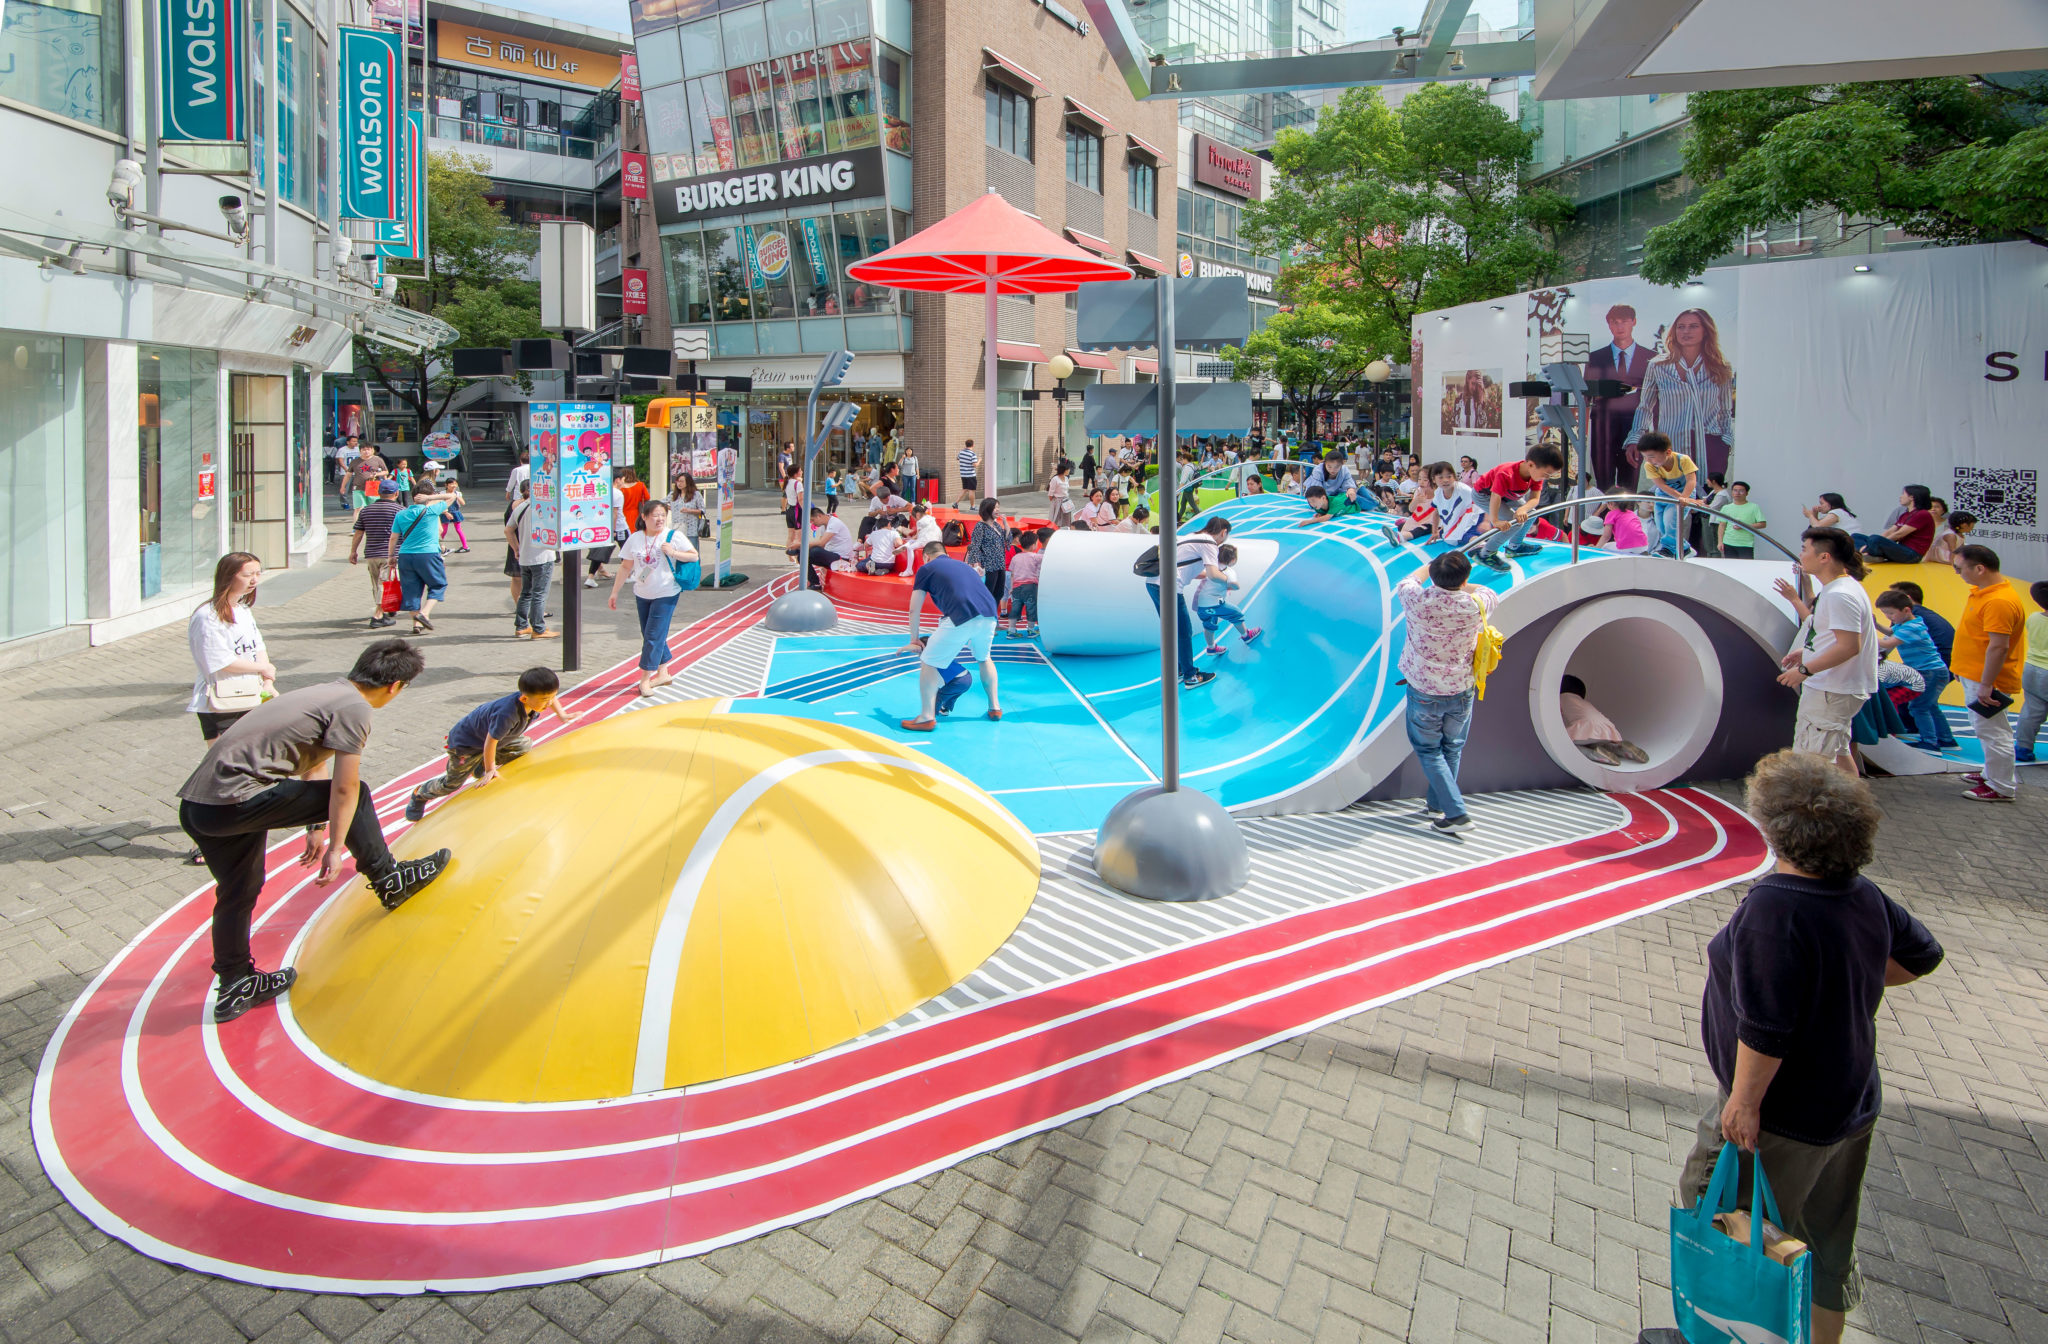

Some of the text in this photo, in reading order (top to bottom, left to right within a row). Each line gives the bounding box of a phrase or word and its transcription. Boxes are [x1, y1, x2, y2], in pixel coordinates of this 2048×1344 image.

[465, 36, 579, 74] 古丽仙 4F
[624, 77, 640, 86] 汉堡
[357, 61, 382, 196] watsons
[675, 160, 855, 213] BURGER KING
[758, 238, 787, 258] BURGER
[760, 246, 788, 270] KING
[1246, 271, 1273, 293] KING
[750, 366, 786, 383] Etam
[537, 470, 552, 483] 六一
[572, 470, 601, 484] 六一
[533, 483, 556, 498] 玩具节
[565, 481, 608, 499] 玩具节
[384, 860, 437, 900] AIR
[219, 973, 288, 1008] AIR
